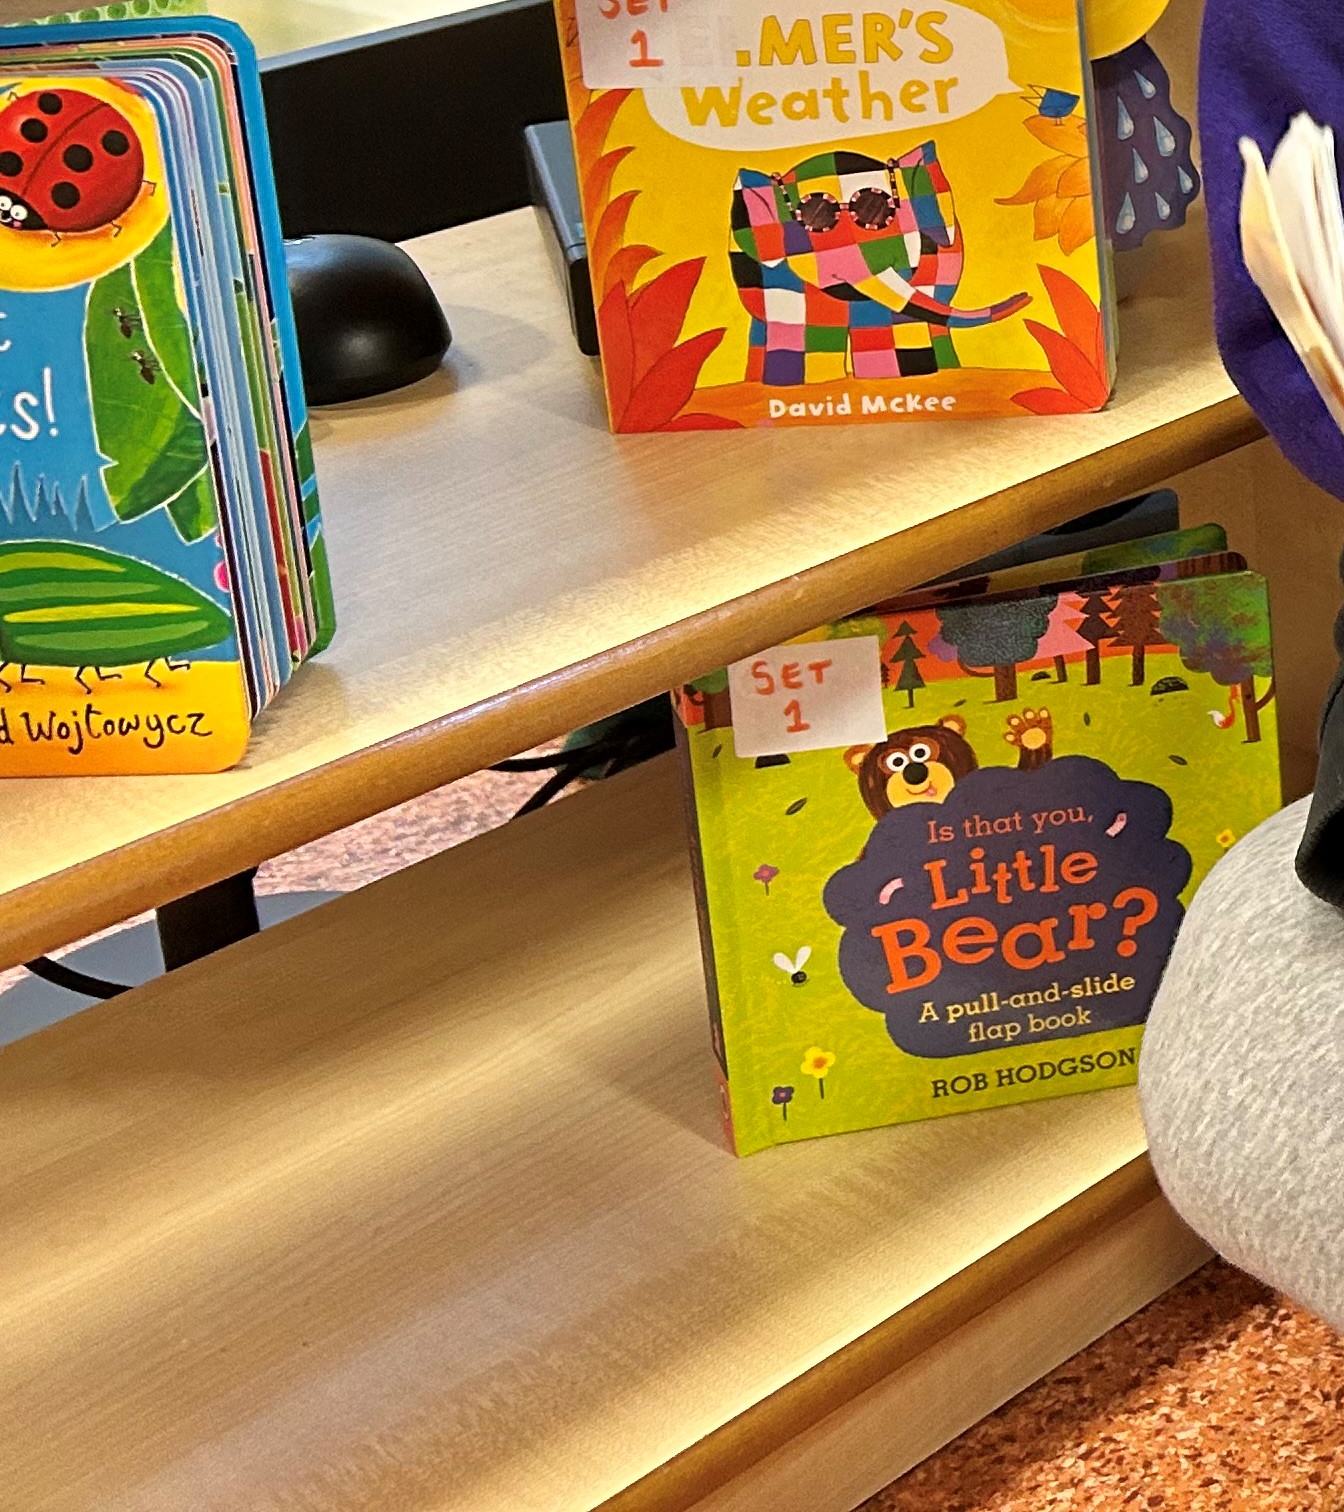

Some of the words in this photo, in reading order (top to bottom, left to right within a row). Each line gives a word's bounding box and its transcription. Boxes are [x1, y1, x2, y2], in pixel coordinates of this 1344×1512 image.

[627, 28, 665, 68] 1
[682, 7, 955, 68] MER'S
[680, 70, 959, 129] Weather
[768, 392, 852, 419] David
[861, 392, 957, 415] McKee
[750, 658, 833, 696] SET
[19, 702, 213, 756] Wojtowycz
[783, 698, 811, 734] 1
[927, 819, 955, 845] Is
[963, 813, 1025, 839] that
[1031, 804, 1095, 835] you,
[922, 843, 1099, 911] Little
[870, 886, 1160, 995] Bear?
[918, 1001, 940, 1024] A
[945, 972, 1136, 1024] pull-and-slide
[967, 1022, 1022, 1044] flap
[1027, 1005, 1092, 1034] book
[931, 1072, 989, 1099] ROB
[996, 1047, 1137, 1088] HODGSON
